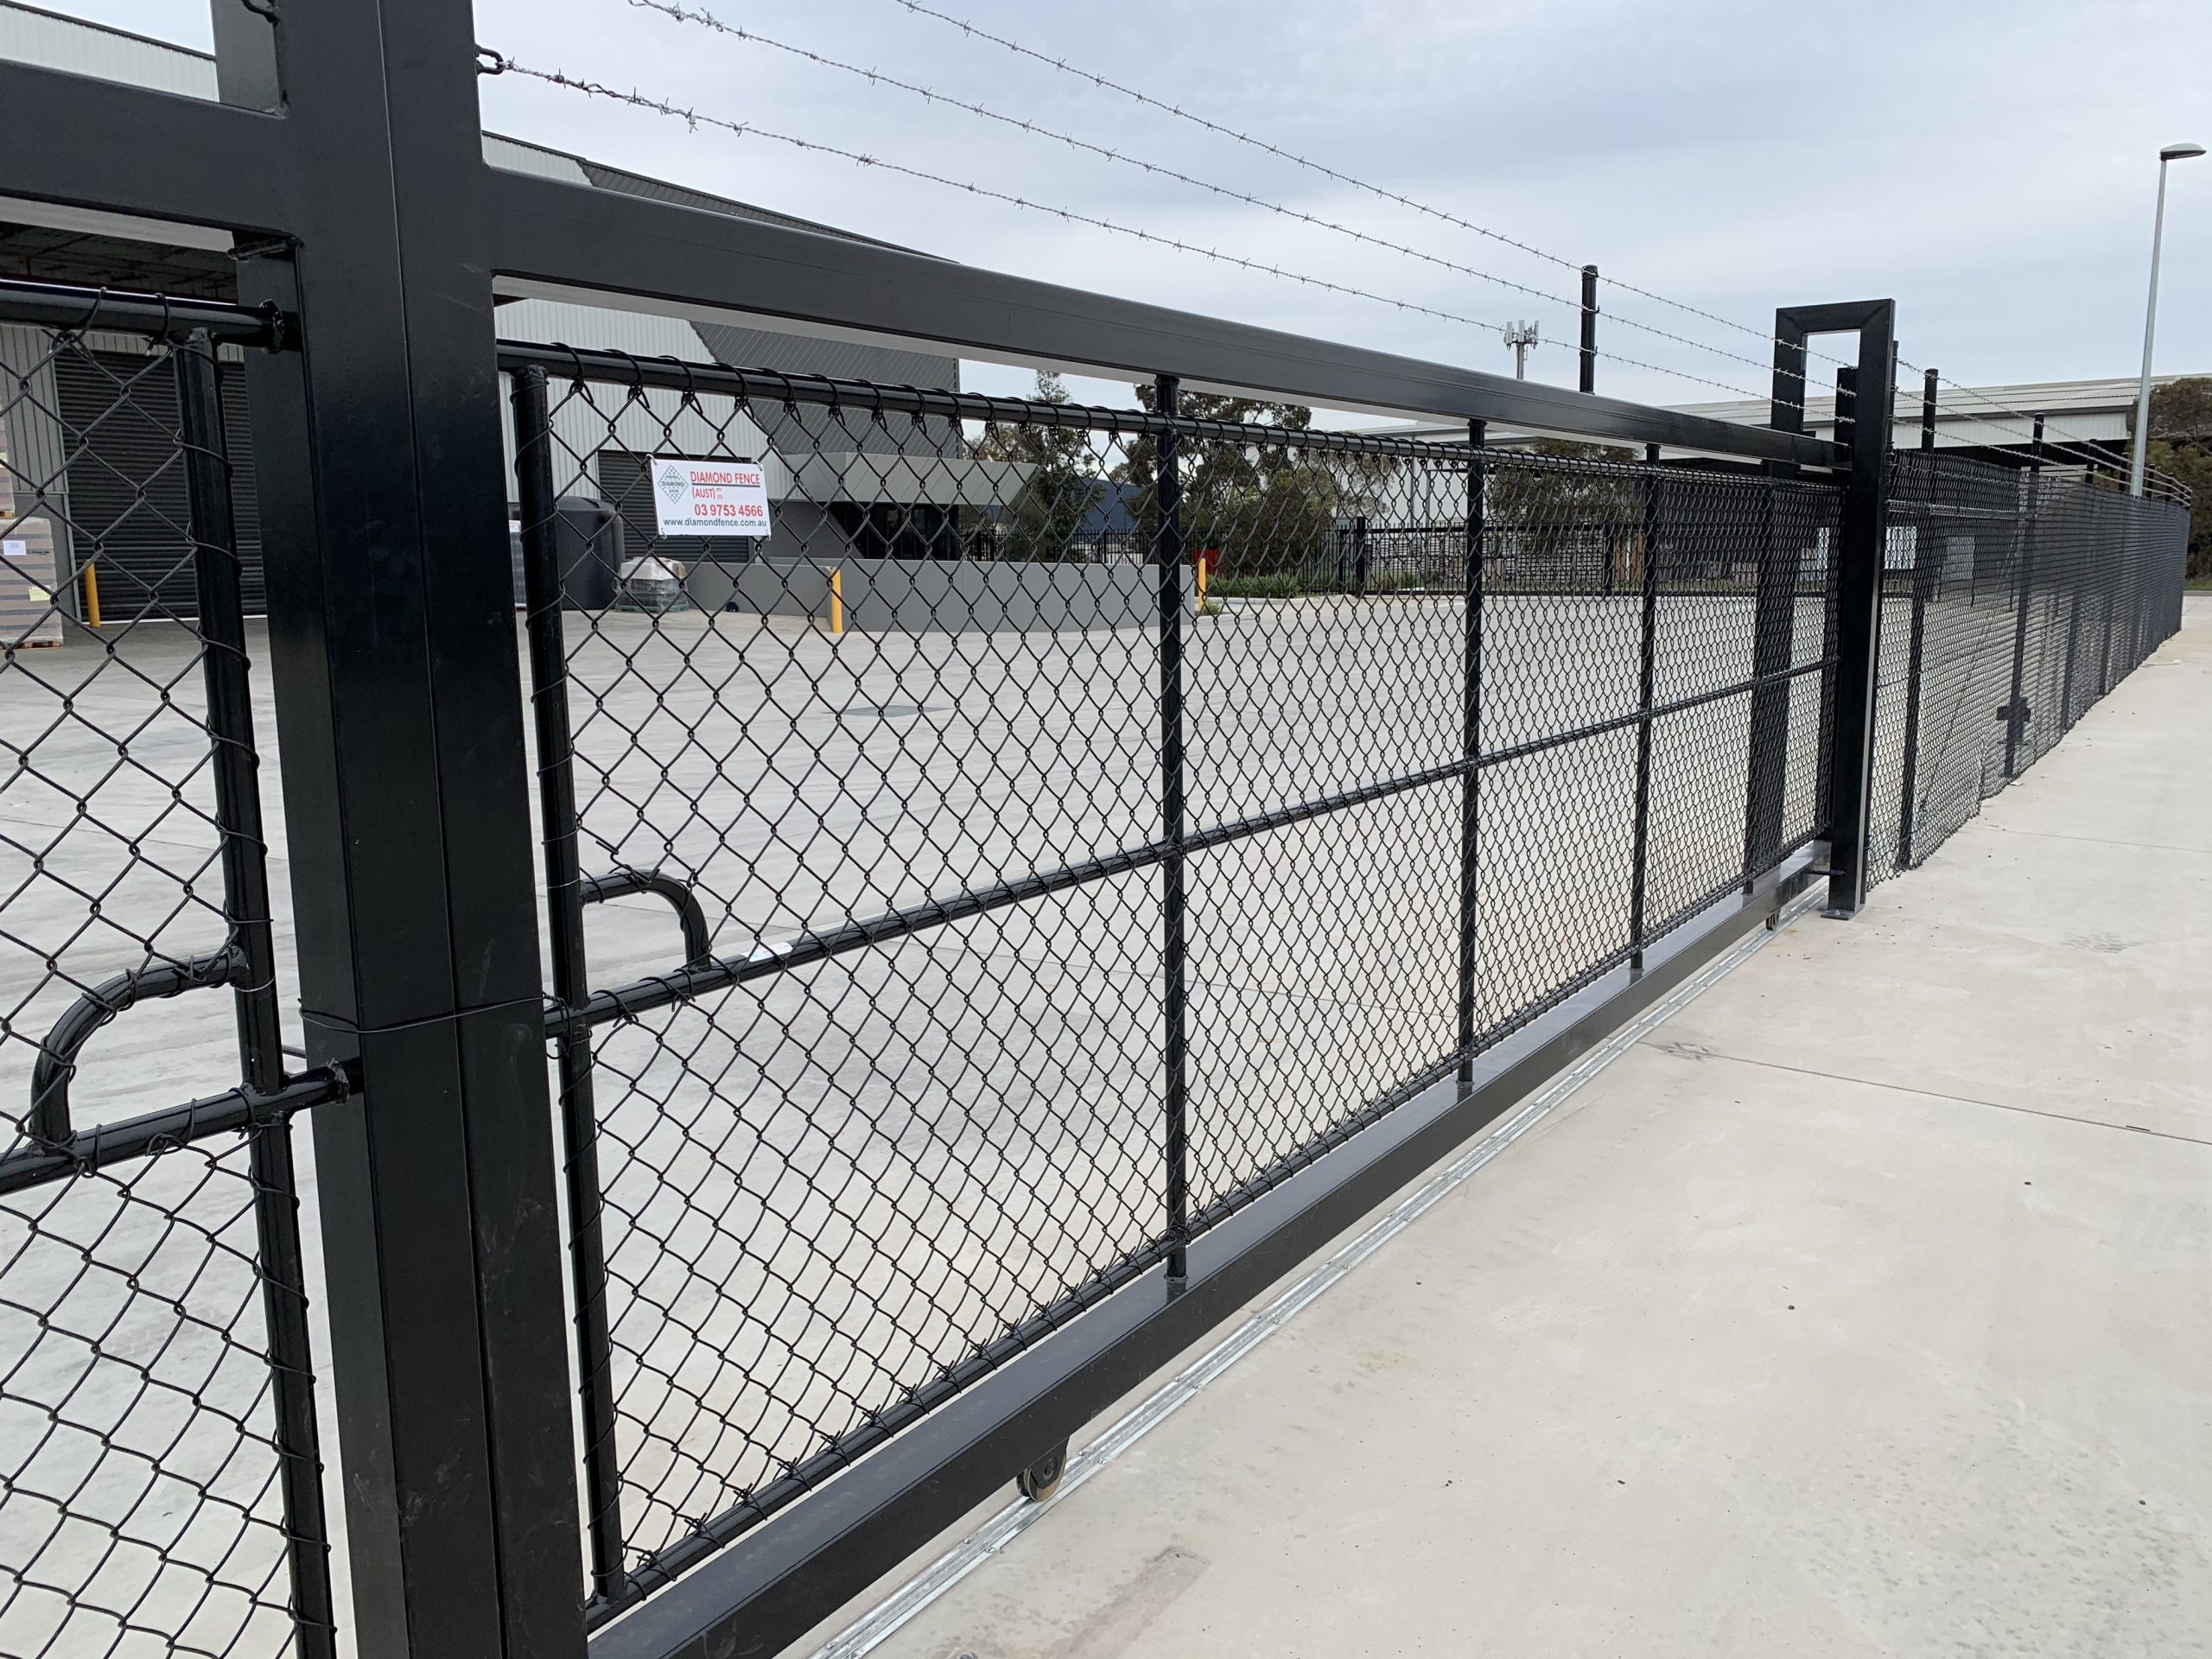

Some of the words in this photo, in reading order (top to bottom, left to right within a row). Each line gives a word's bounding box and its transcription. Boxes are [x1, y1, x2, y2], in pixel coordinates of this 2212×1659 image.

[690, 471, 733, 484] DIAMOND
[734, 473, 760, 485] FENCE
[692, 486, 715, 500] (AUST)
[694, 504, 708, 516] 03
[710, 504, 736, 517] 9753
[738, 505, 763, 517] 4566
[664, 518, 766, 527] www.diamondfence.com.au
